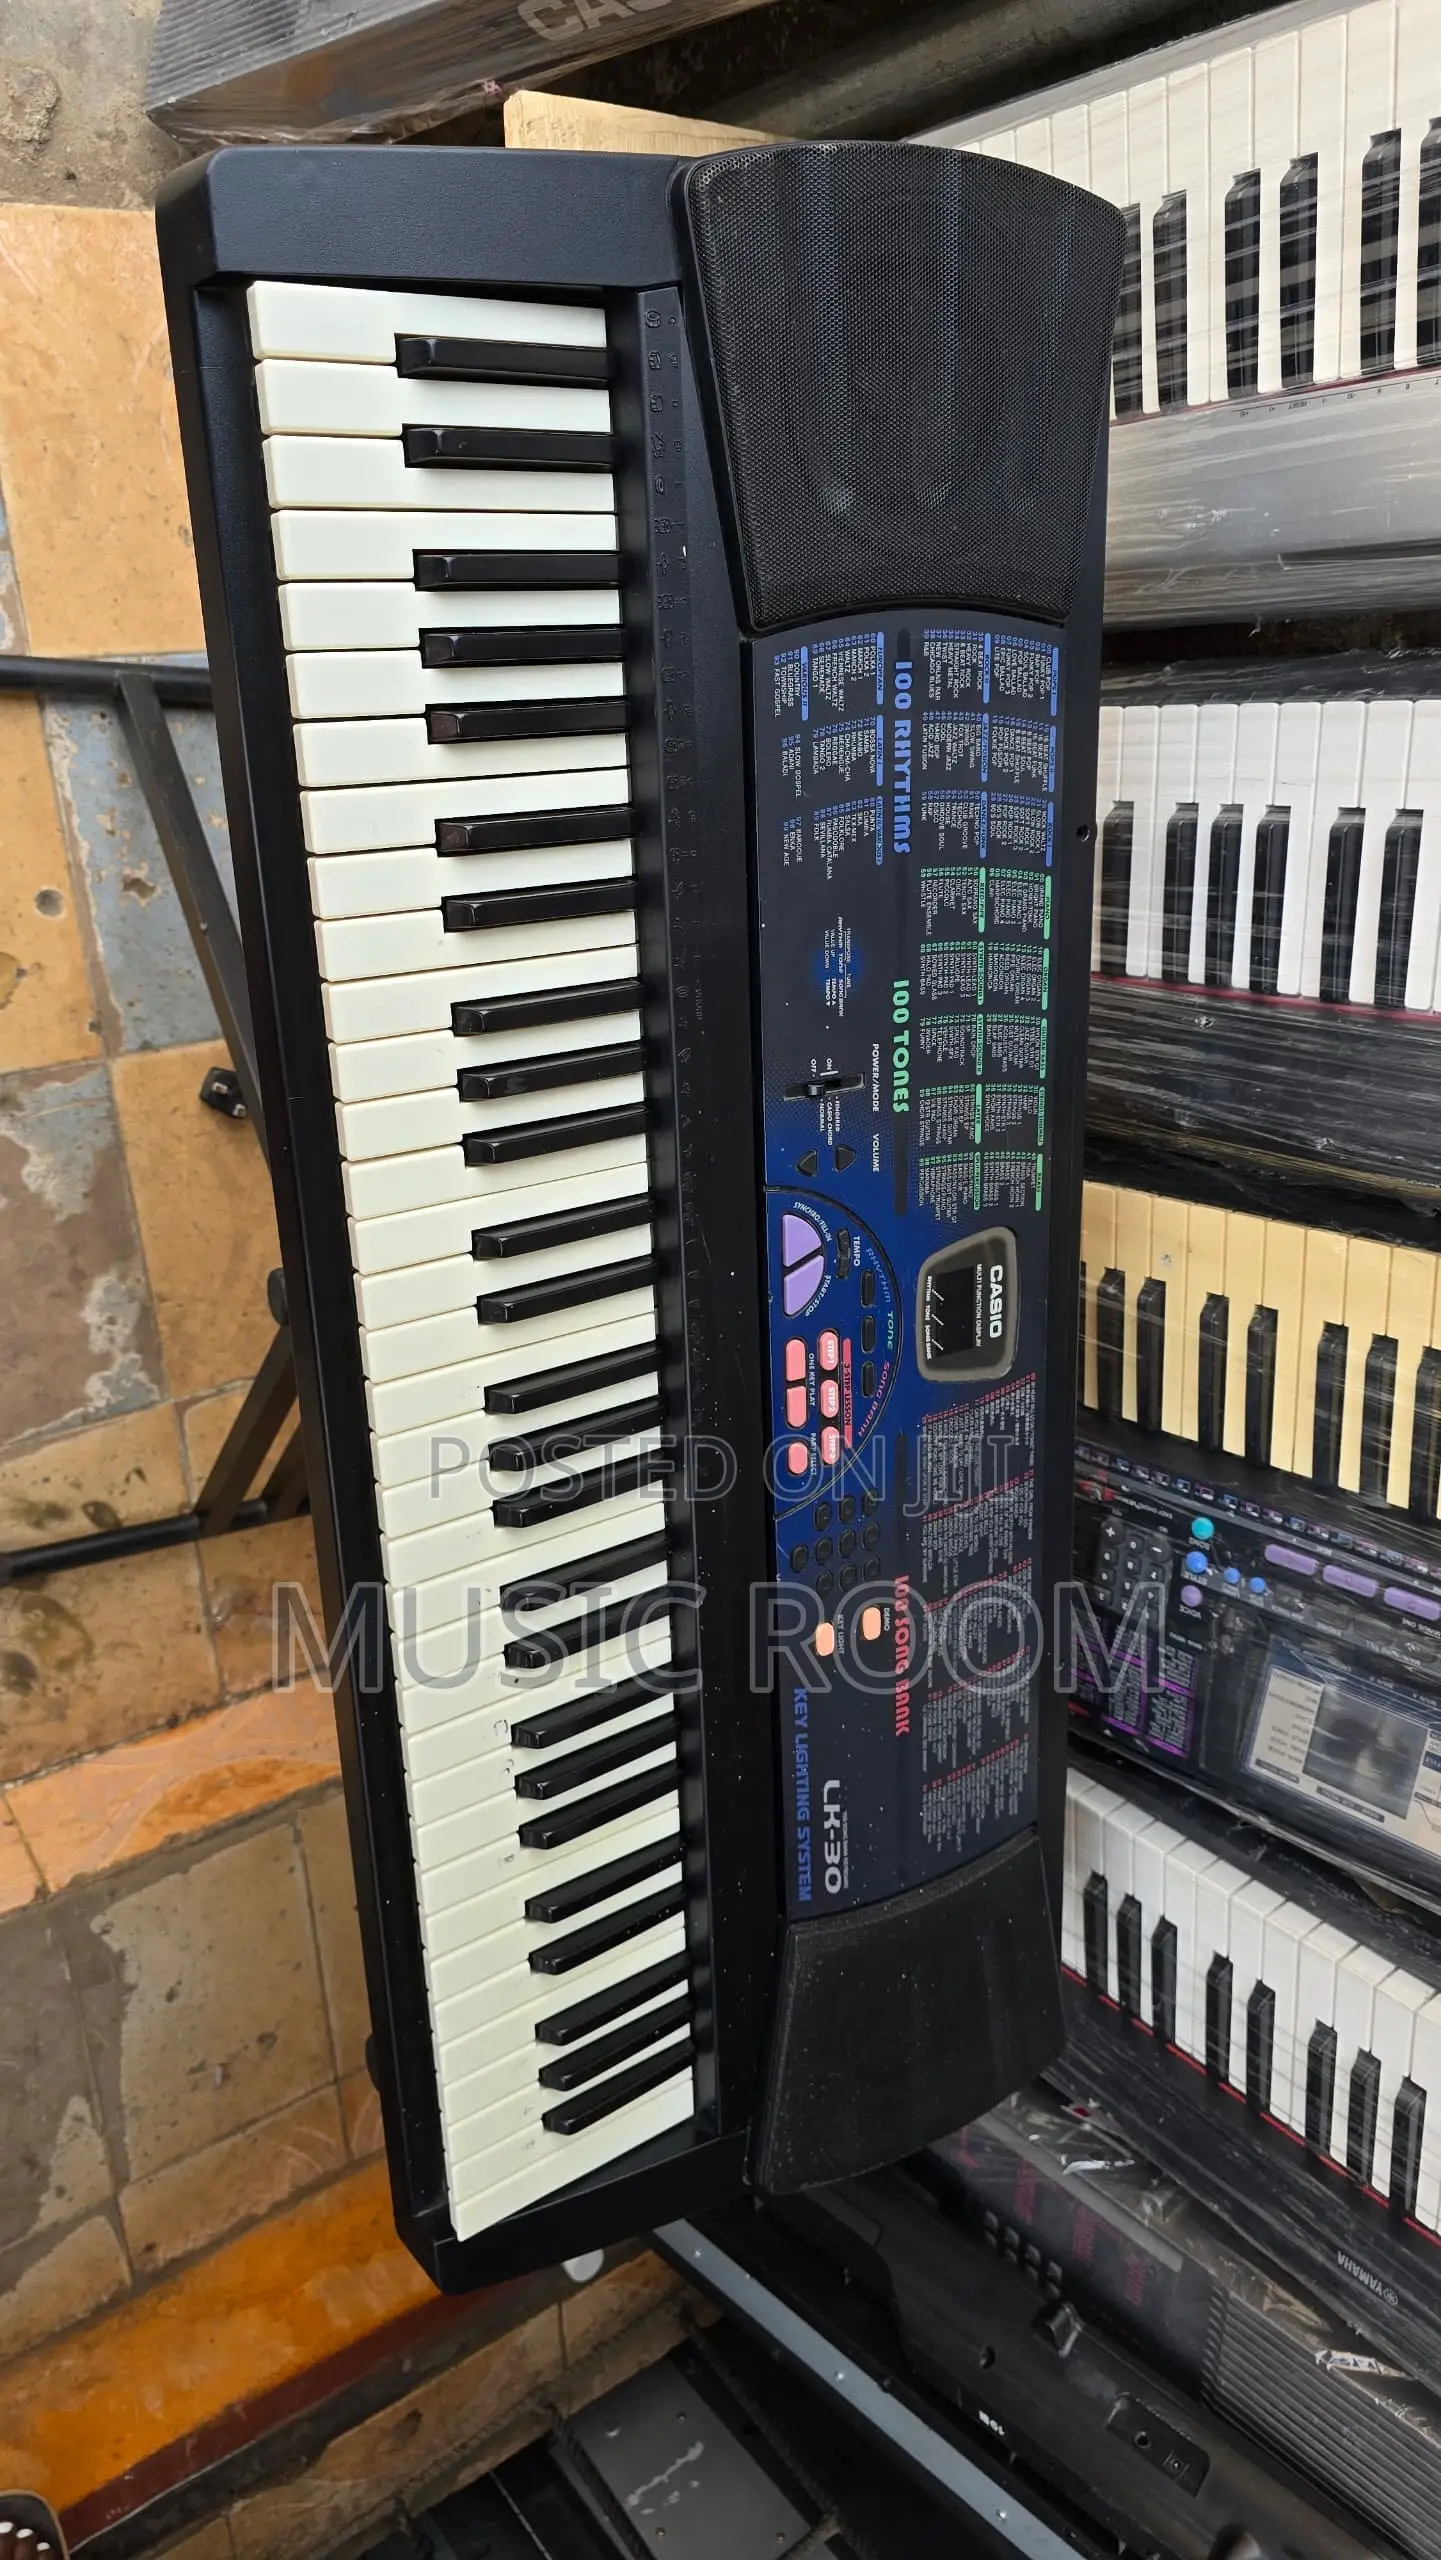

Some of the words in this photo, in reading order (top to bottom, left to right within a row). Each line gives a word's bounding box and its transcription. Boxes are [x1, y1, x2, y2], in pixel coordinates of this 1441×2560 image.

[894, 661, 912, 710] 100
[894, 720, 912, 854] RHYTHMS
[893, 980, 910, 1024] 100
[826, 1058, 832, 1070] ON
[893, 1030, 910, 1113] TONES
[792, 1202, 832, 1242] SYNCHRO/FILL-IN
[804, 1274, 832, 1317] START/STOP
[865, 1248, 891, 1303] RHYTHM
[990, 1264, 1003, 1338] CASIO
[876, 1360, 890, 1400] SONG
[857, 1400, 879, 1437] BANK
[894, 1617, 910, 1674] SONG
[794, 1688, 808, 1728] KEY
[895, 1678, 910, 1736] BANK
[795, 1733, 810, 1820] LIGHTING
[823, 1780, 842, 1894] LK-30
[796, 1826, 812, 1901] SYSTEM
[1336, 2250, 1383, 2297] YAMAHA
